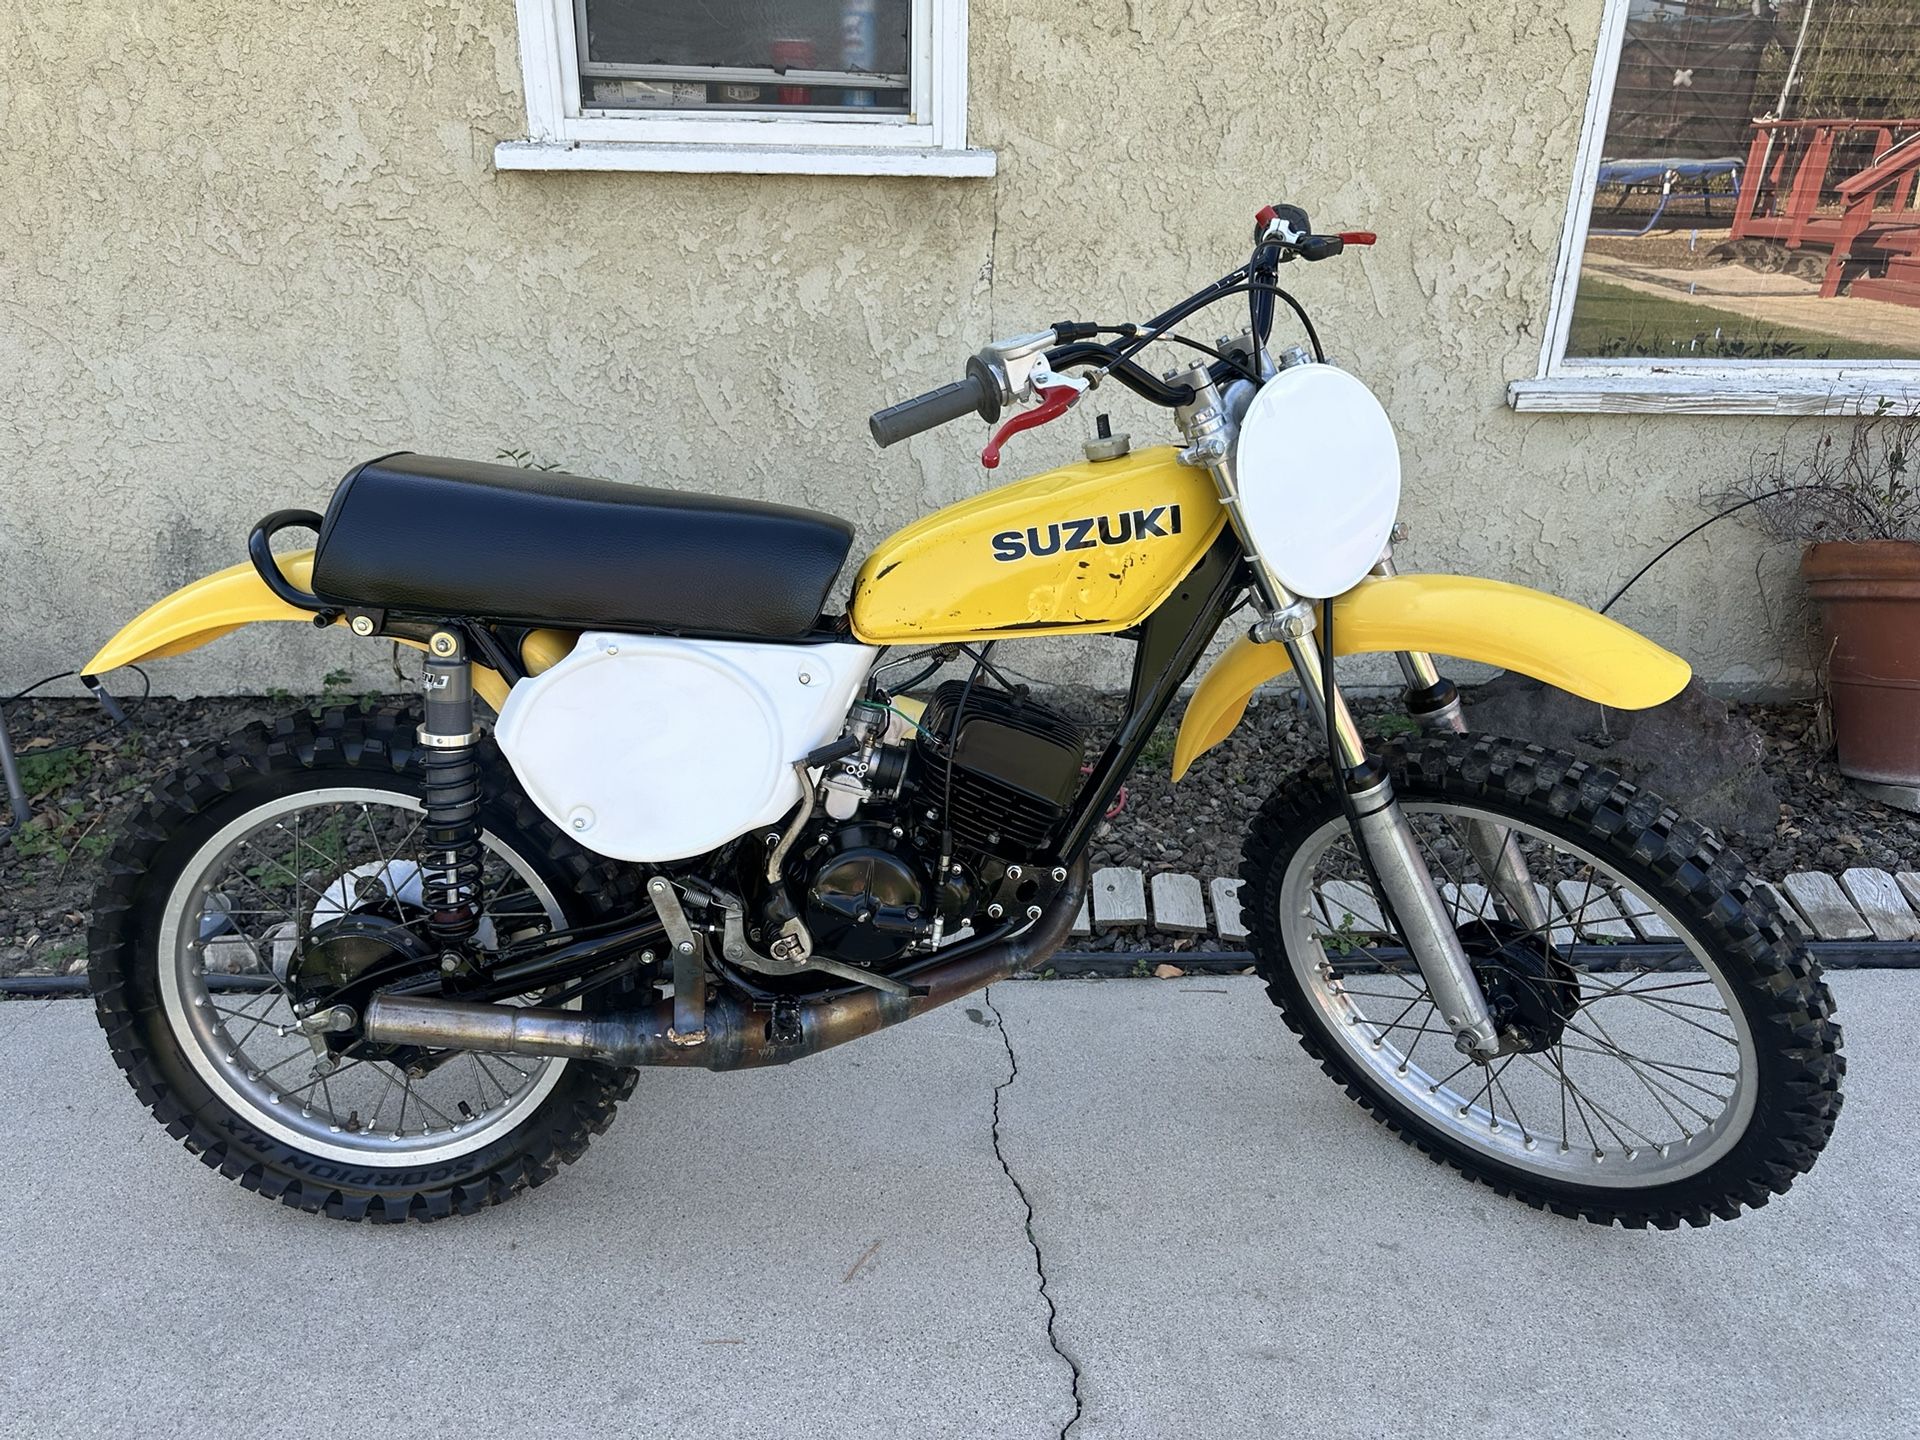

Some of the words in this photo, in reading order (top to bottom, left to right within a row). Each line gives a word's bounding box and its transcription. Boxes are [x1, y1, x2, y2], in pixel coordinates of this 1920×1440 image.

[991, 504, 1182, 562] SUZUKI
[217, 1118, 276, 1152] MX
[280, 1154, 479, 1187] SCORPION
